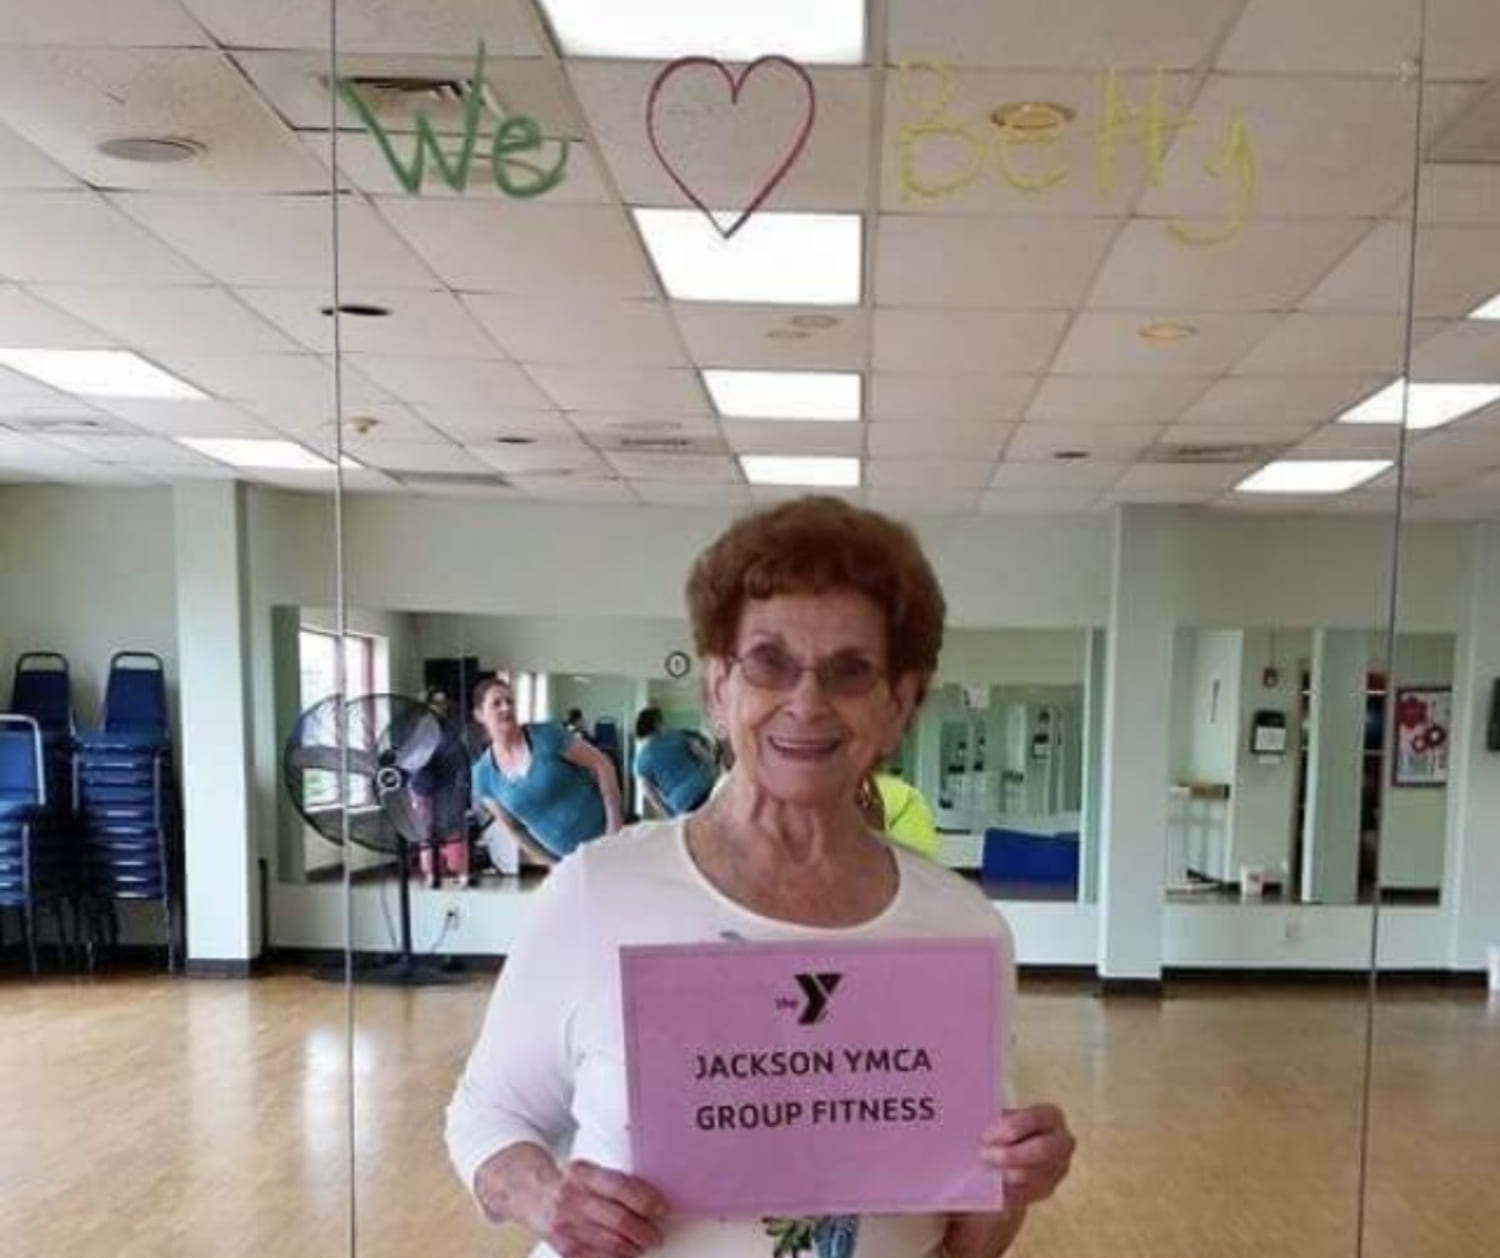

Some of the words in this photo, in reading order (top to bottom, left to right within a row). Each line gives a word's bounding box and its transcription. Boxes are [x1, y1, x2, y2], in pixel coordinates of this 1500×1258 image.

[336, 40, 569, 198] We
[897, 58, 1256, 247] Betty
[793, 972, 844, 1025] Y
[695, 1050, 834, 1080] JACKSON
[843, 1048, 932, 1074] YMCA
[695, 1102, 802, 1131] GROUP
[811, 1097, 935, 1124] FITNESS
